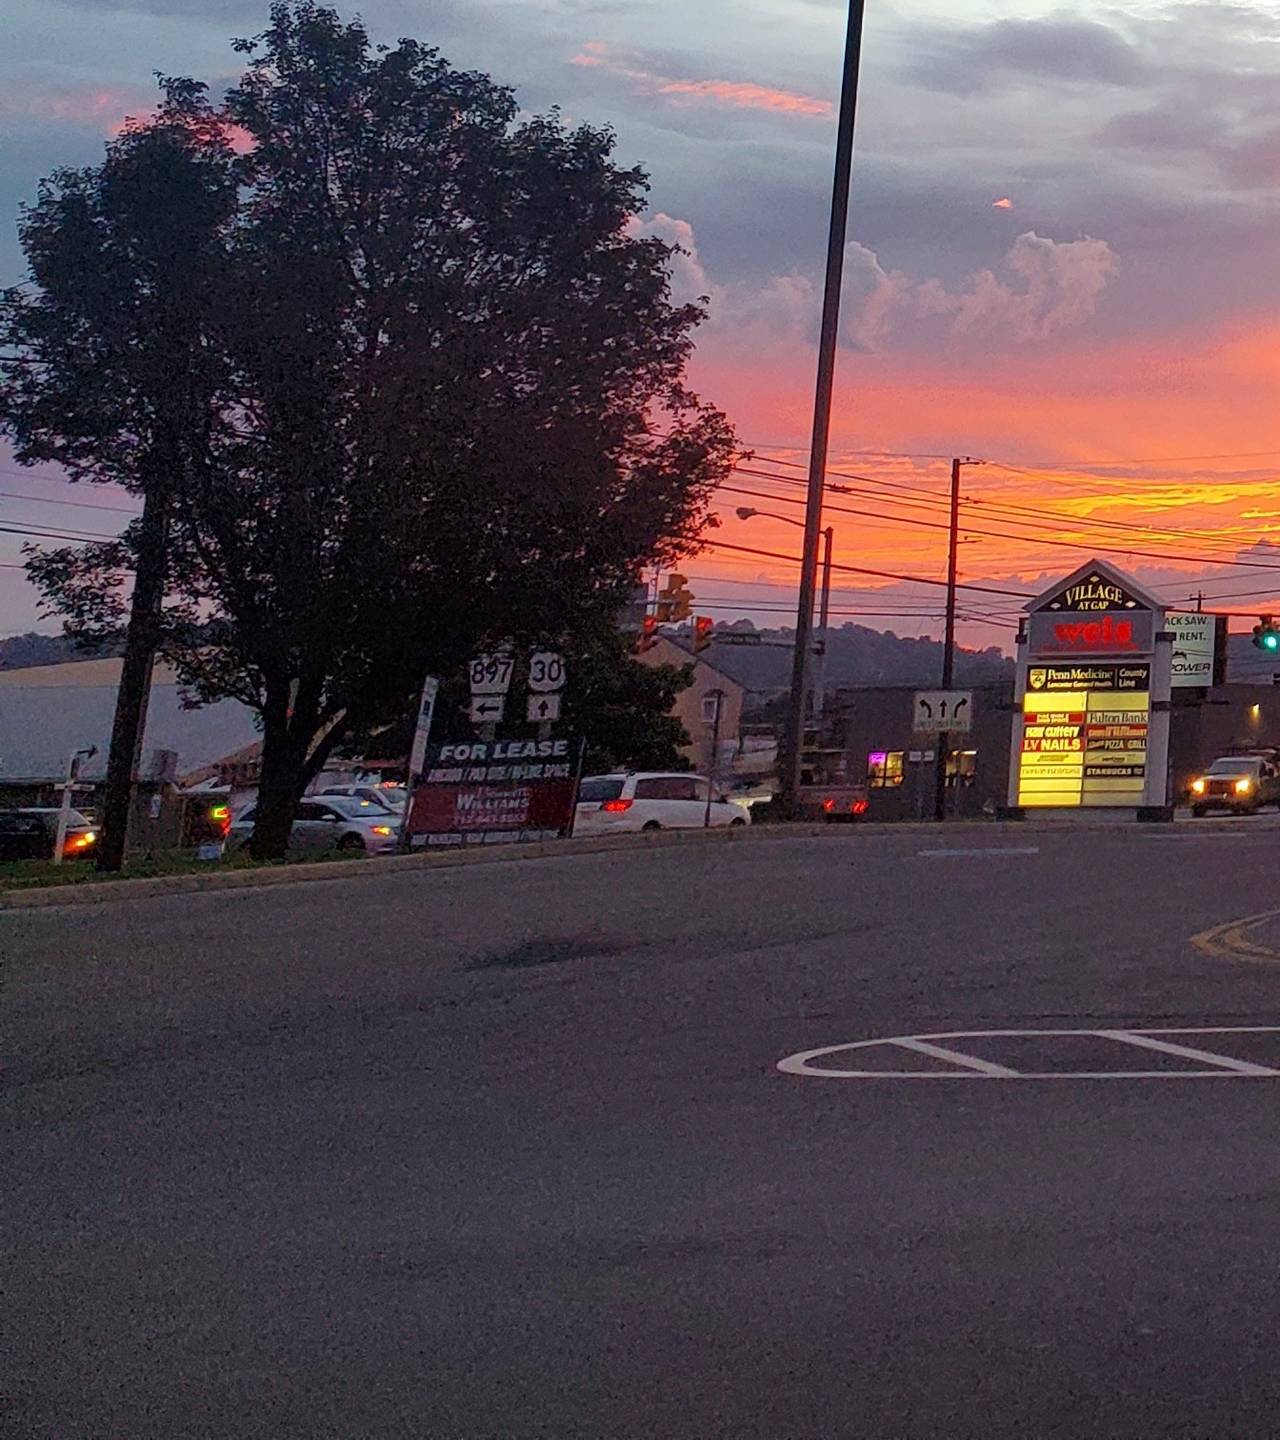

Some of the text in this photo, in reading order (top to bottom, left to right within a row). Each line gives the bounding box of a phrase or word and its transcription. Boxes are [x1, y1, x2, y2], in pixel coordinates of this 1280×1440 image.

[1065, 584, 1123, 606] VILLAGE
[1077, 600, 1109, 610] AT GAP
[472, 661, 512, 685] 897
[533, 660, 561, 682] 30
[1048, 669, 1113, 680] Penn Medicine
[1119, 668, 1148, 679] County
[1119, 679, 1136, 688] Line
[1090, 712, 1121, 723] Fulton
[1024, 739, 1040, 751] LV
[1040, 738, 1081, 751] NAILS
[440, 740, 569, 761] FOR LEASE
[1086, 767, 1132, 776] STARBUCKS
